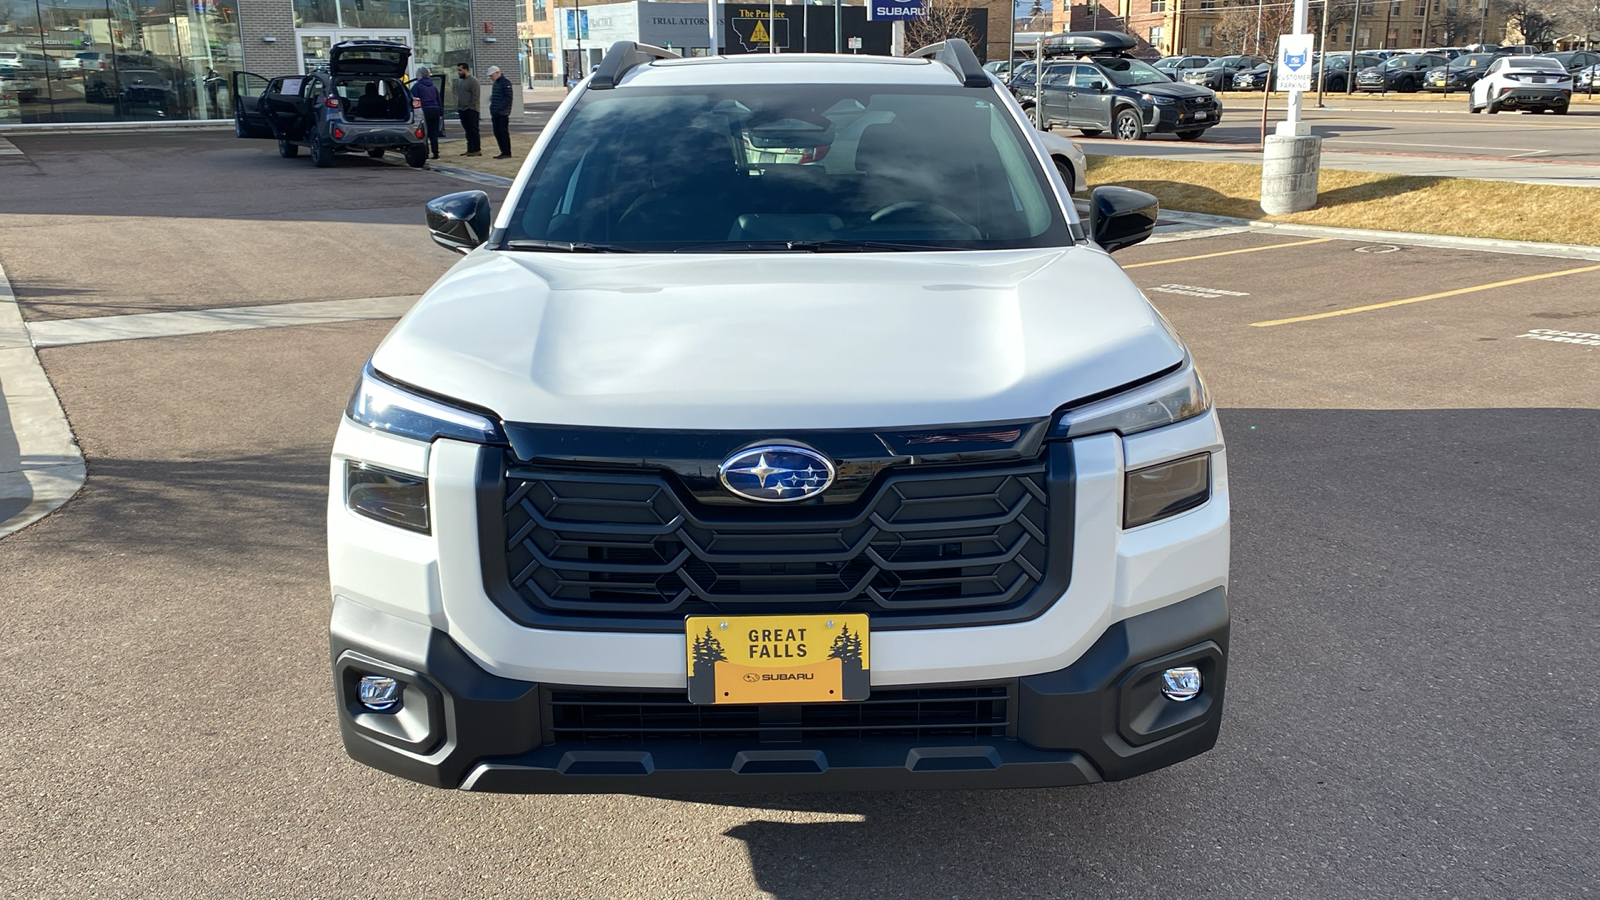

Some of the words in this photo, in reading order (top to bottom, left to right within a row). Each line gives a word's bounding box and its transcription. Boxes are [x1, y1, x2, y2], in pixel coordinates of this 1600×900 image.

[739, 8, 754, 18] The
[877, 7, 926, 16] SUBARU
[651, 17, 677, 25] TRIAL
[748, 628, 807, 642] GREAT
[749, 643, 807, 659] FALLS
[762, 673, 814, 681] SUBARU
